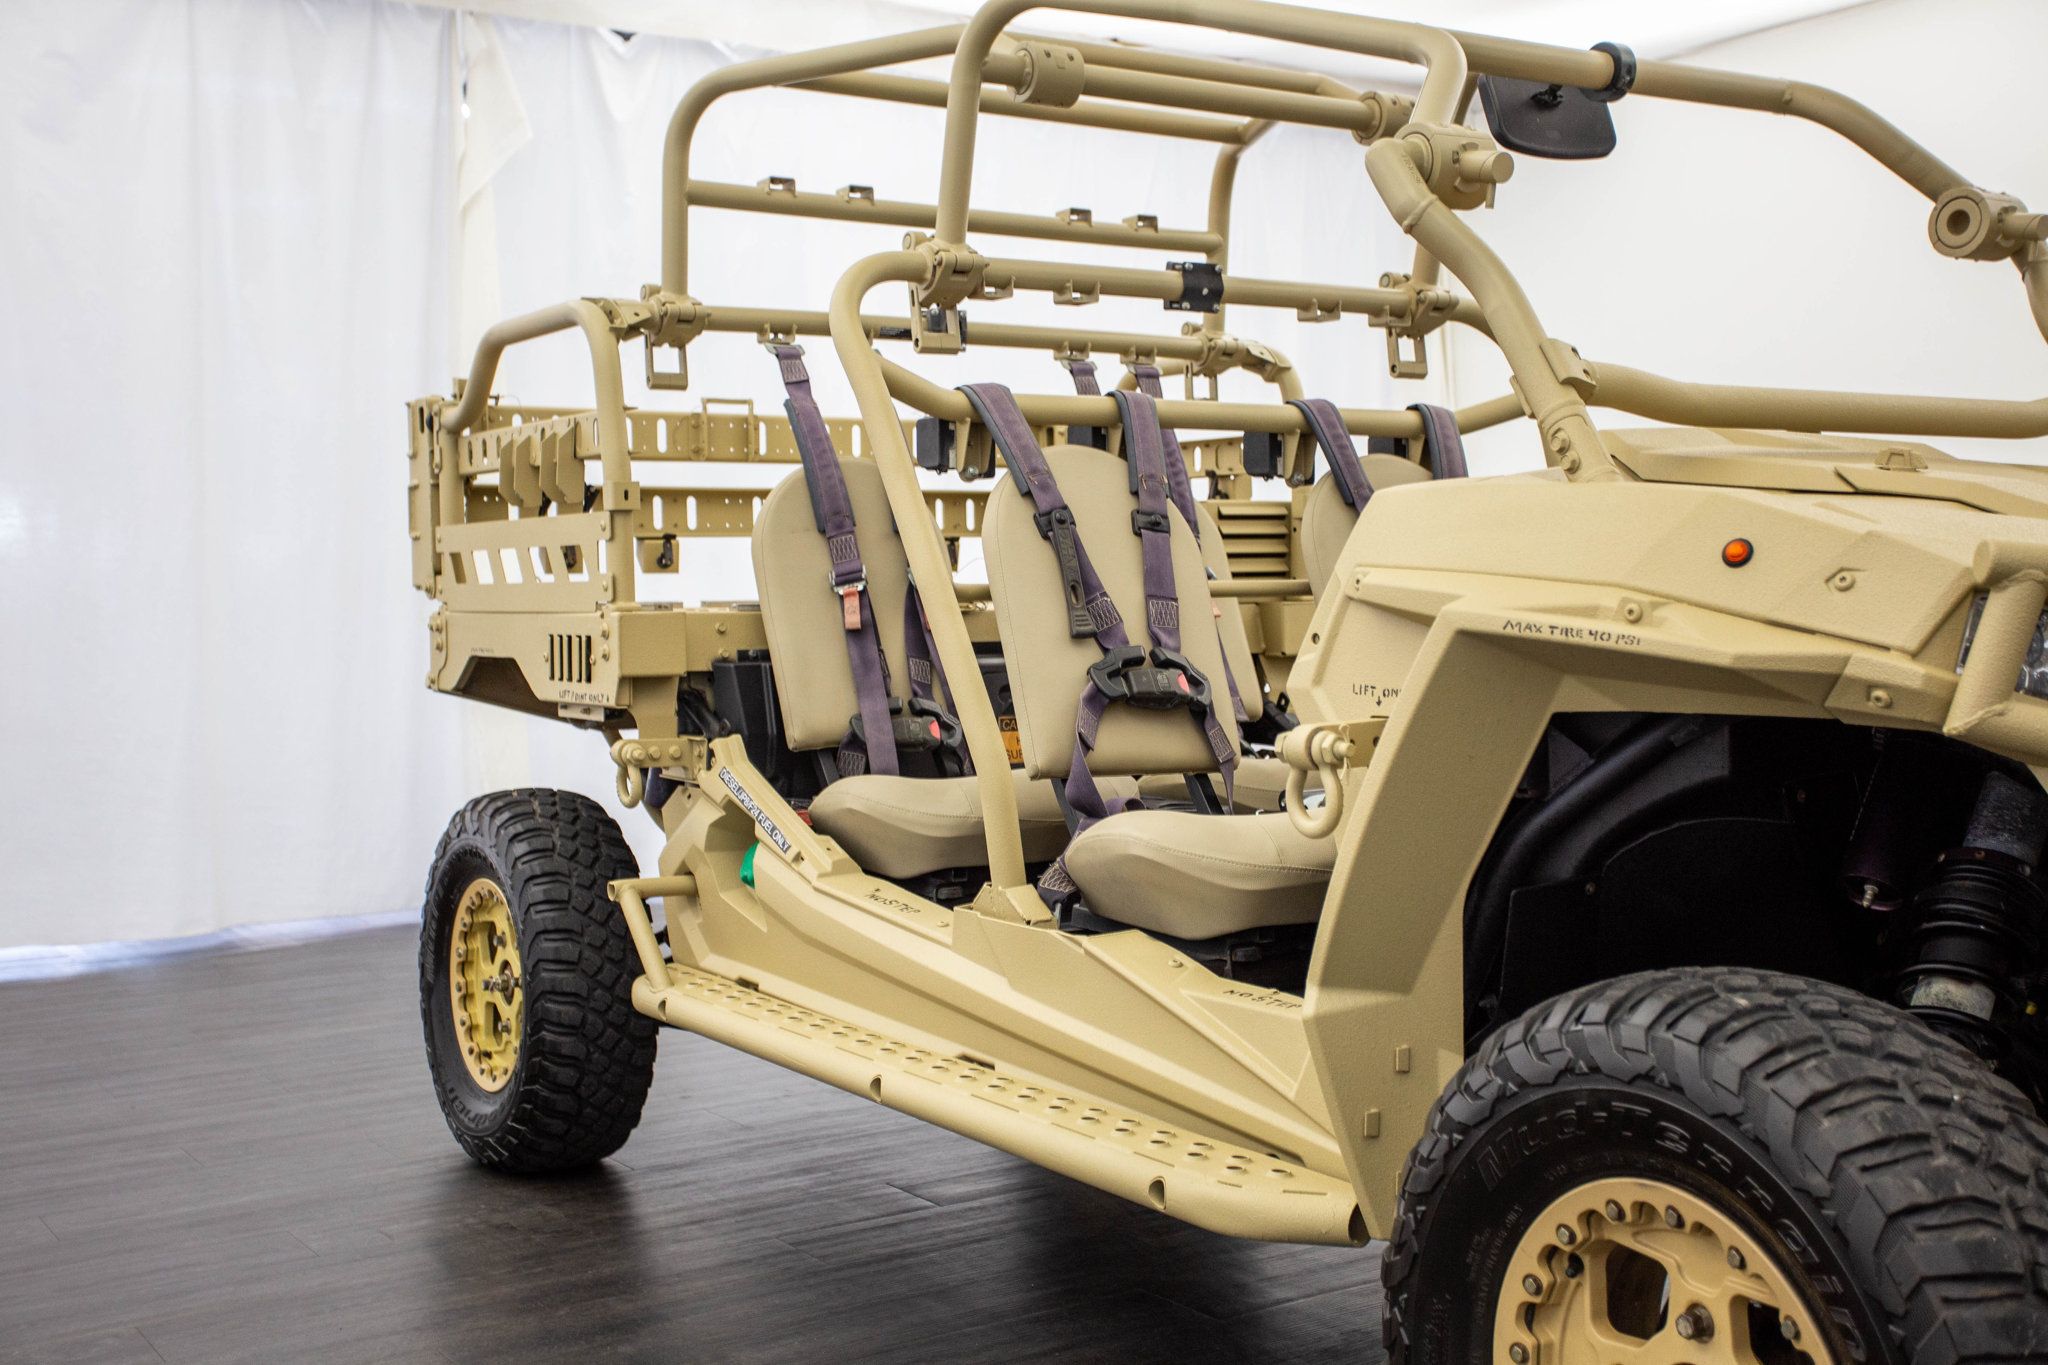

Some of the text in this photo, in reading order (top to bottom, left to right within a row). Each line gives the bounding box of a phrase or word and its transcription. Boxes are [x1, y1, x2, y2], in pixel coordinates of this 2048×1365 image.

[1502, 619, 1641, 646] MAX TIRE 40 PSI
[559, 690, 571, 699] LIFT
[588, 693, 604, 703] ONLY
[1352, 683, 1402, 698] LIFT ON
[1002, 720, 1017, 731] CA
[757, 813, 775, 835] FUEL
[772, 831, 790, 852] ONLY
